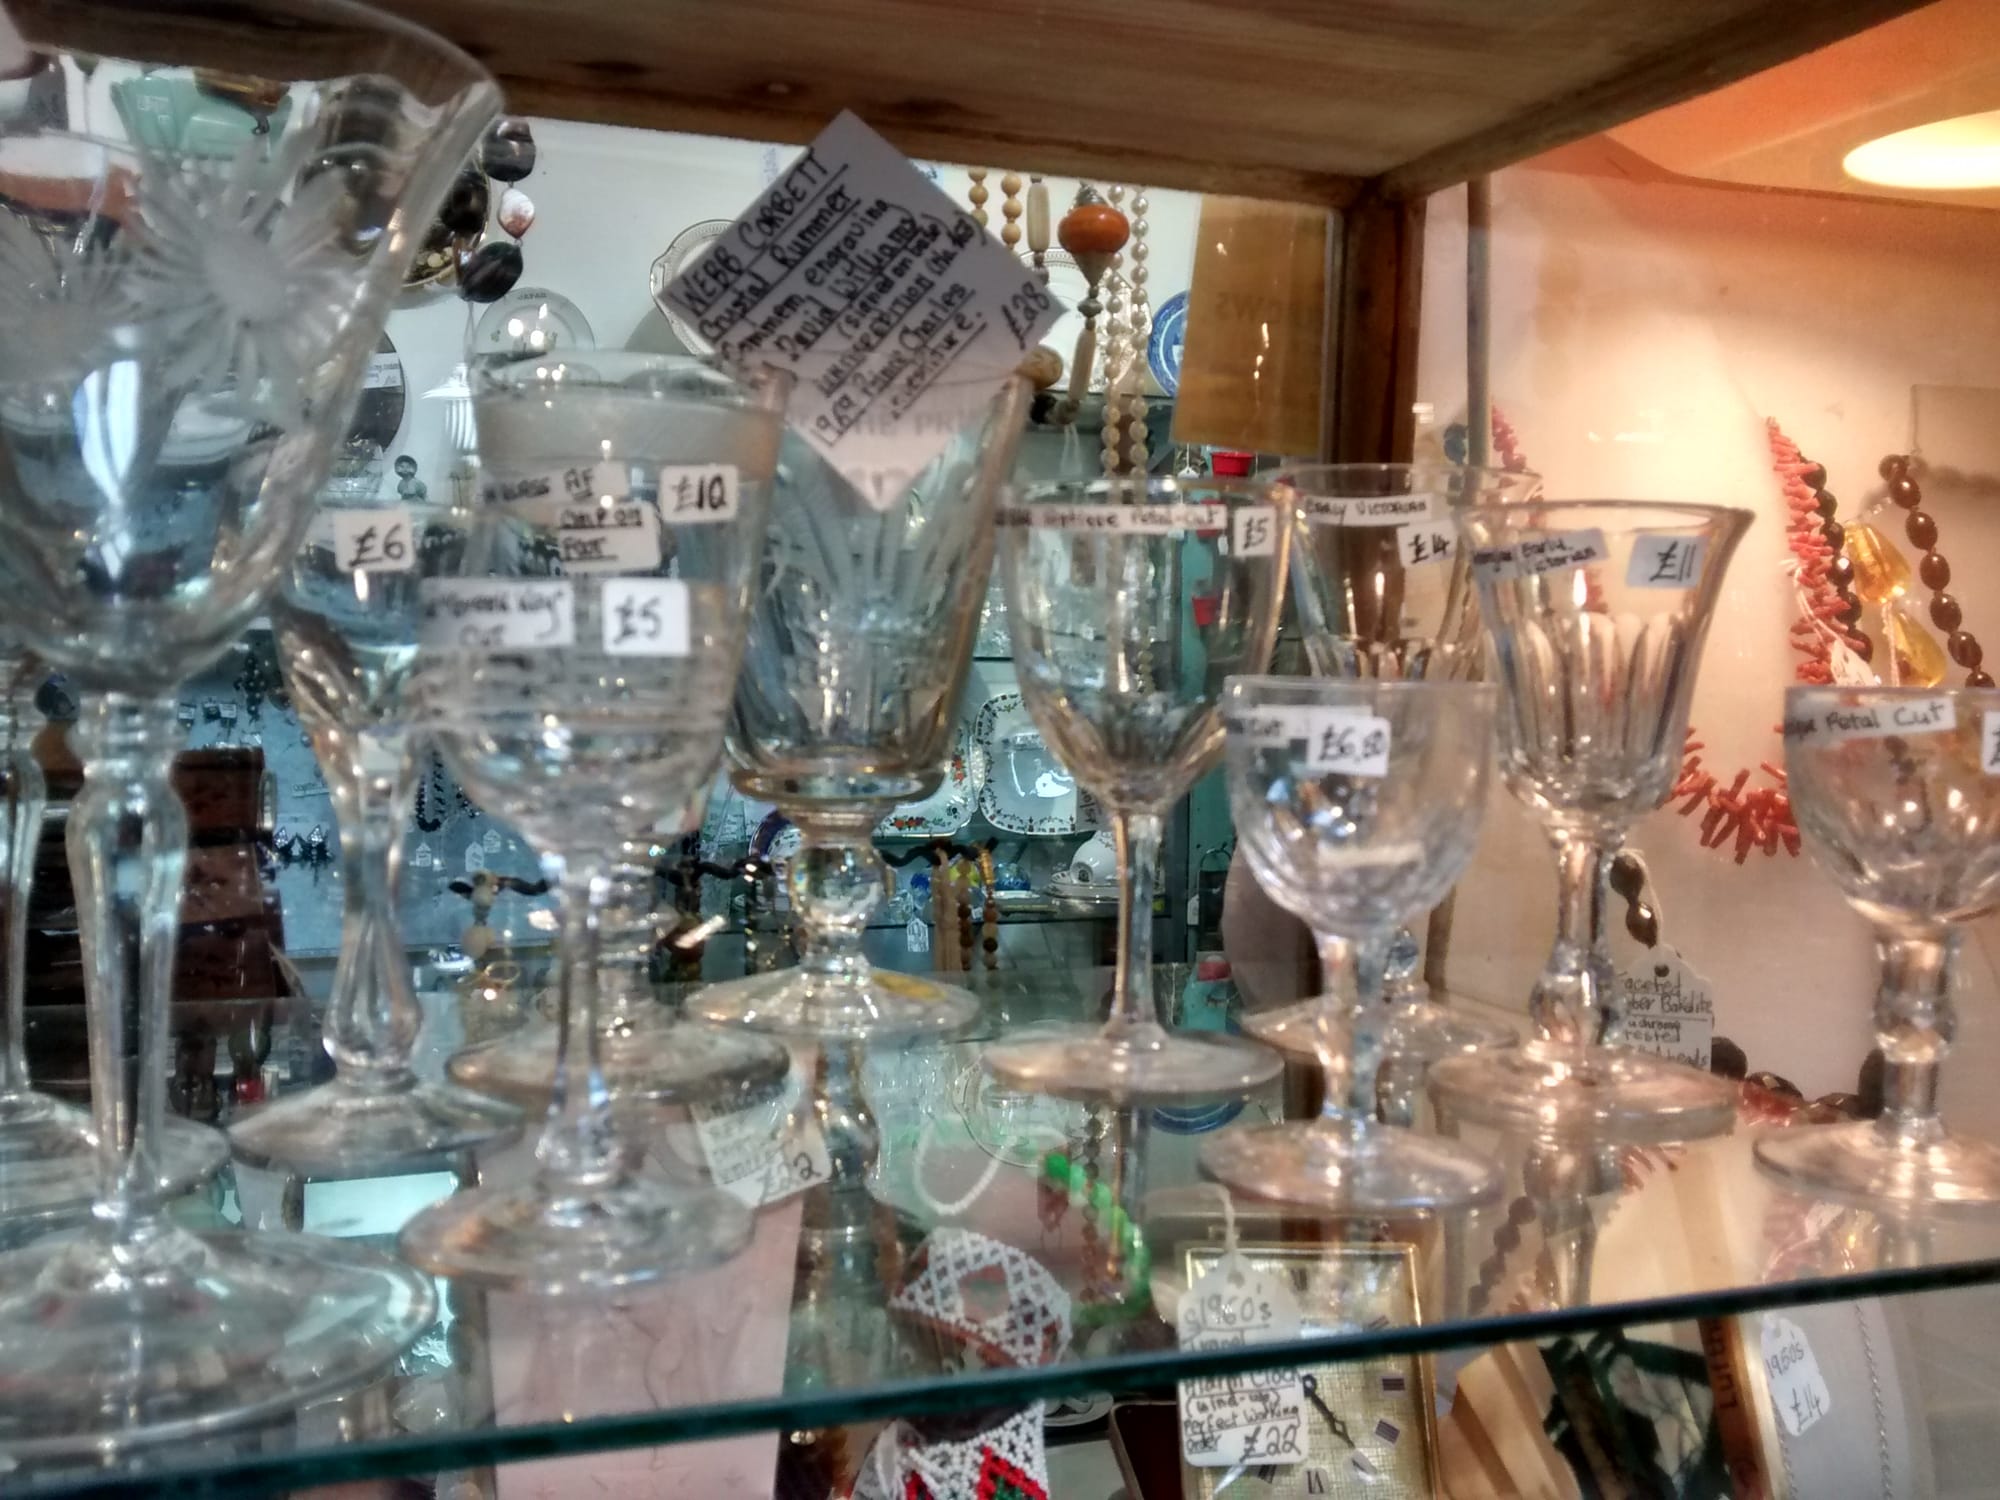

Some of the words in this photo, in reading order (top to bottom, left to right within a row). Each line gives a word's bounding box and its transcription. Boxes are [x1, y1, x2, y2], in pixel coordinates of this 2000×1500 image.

[669, 247, 743, 317] WEBB
[738, 147, 828, 250] CORBETT
[771, 184, 851, 267] Rummer
[898, 282, 968, 351] Charles
[671, 474, 727, 511] £10
[348, 523, 405, 568] £6
[1242, 515, 1270, 550] £5
[1649, 540, 1698, 583] £11
[614, 595, 662, 645] £5
[1893, 700, 1945, 727] Cut
[1790, 1383, 1824, 1432] £14
[1240, 1424, 1302, 1463] £22
